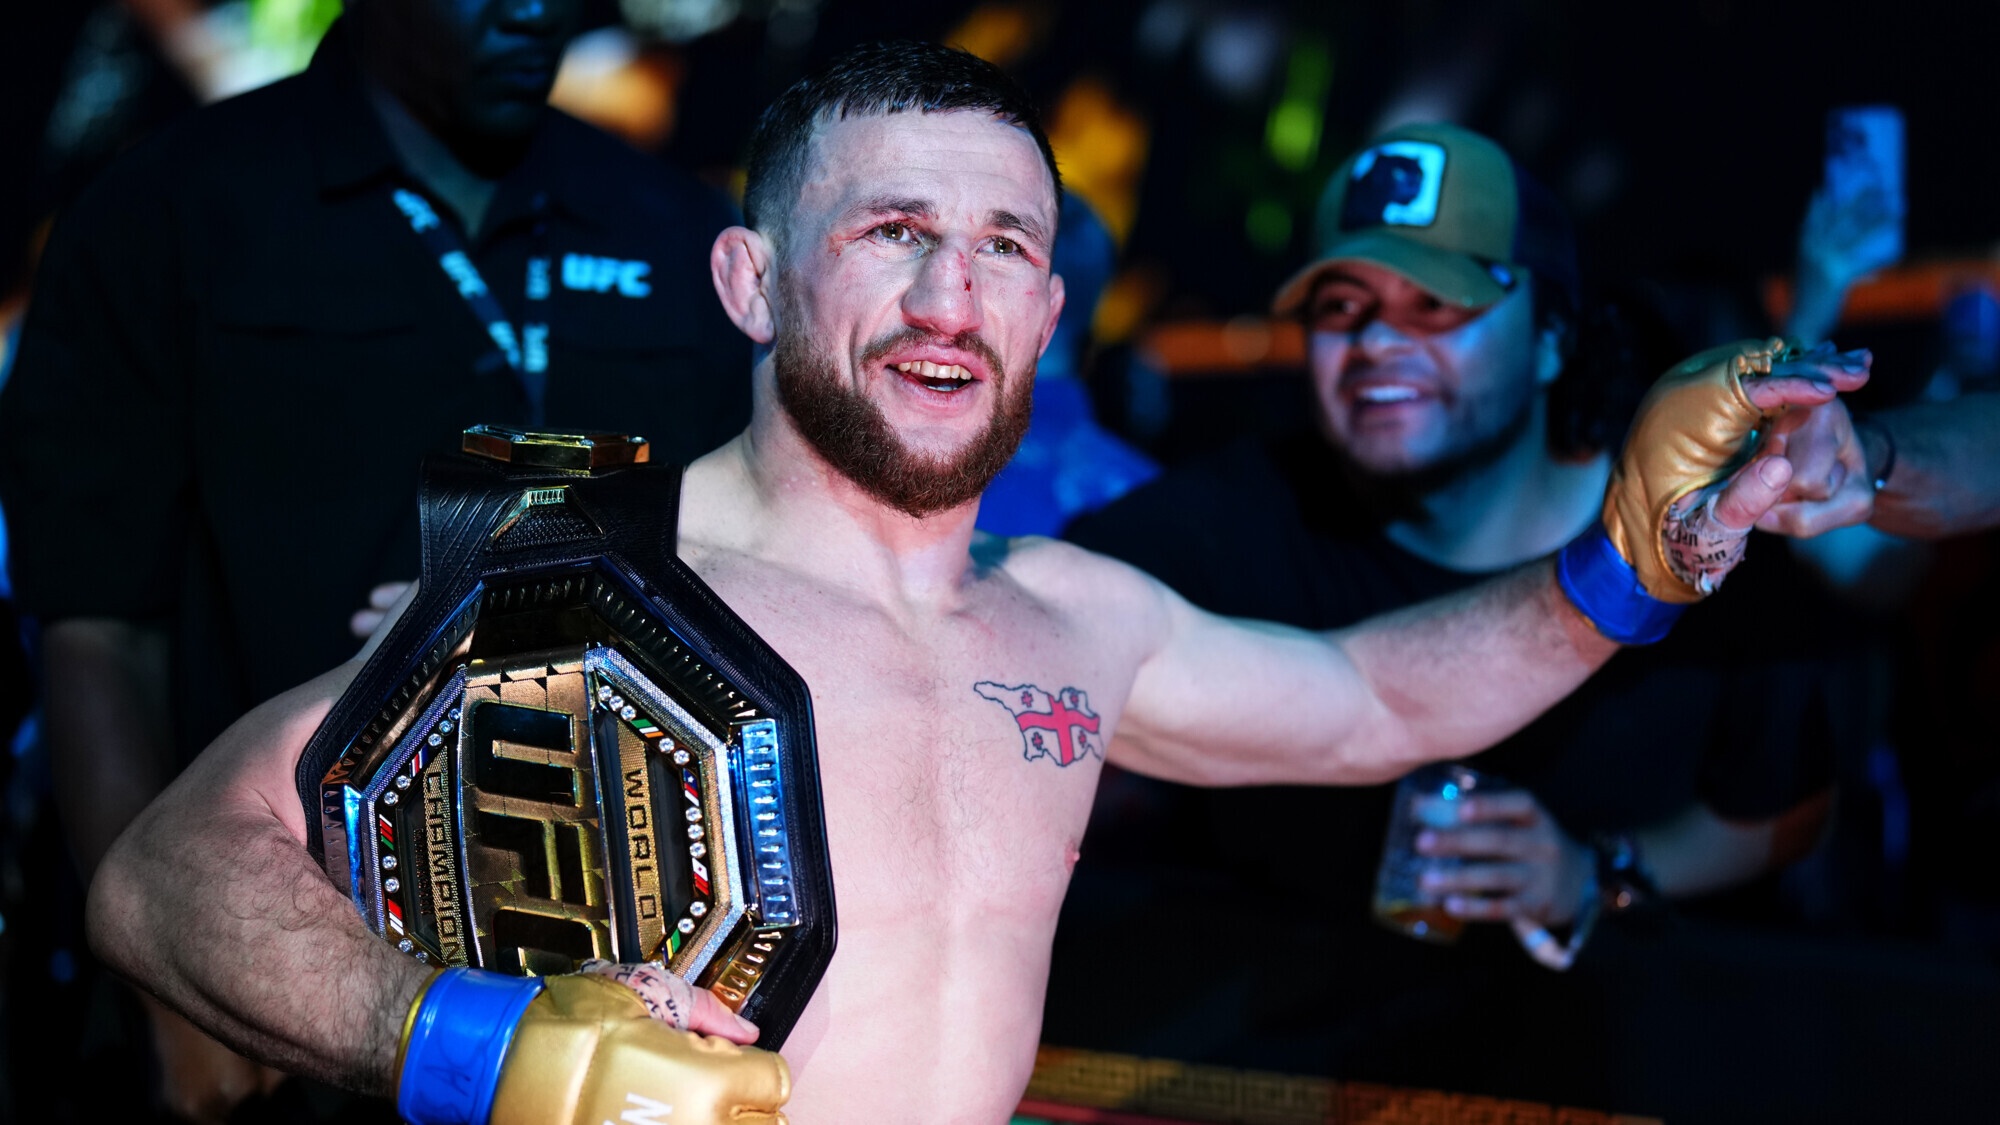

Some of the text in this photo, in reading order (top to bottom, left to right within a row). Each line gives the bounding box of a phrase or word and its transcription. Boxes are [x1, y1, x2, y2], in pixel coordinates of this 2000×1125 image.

[561, 253, 652, 299] UFC
[426, 772, 461, 966] CHAMPION
[624, 768, 657, 920] WORLD
